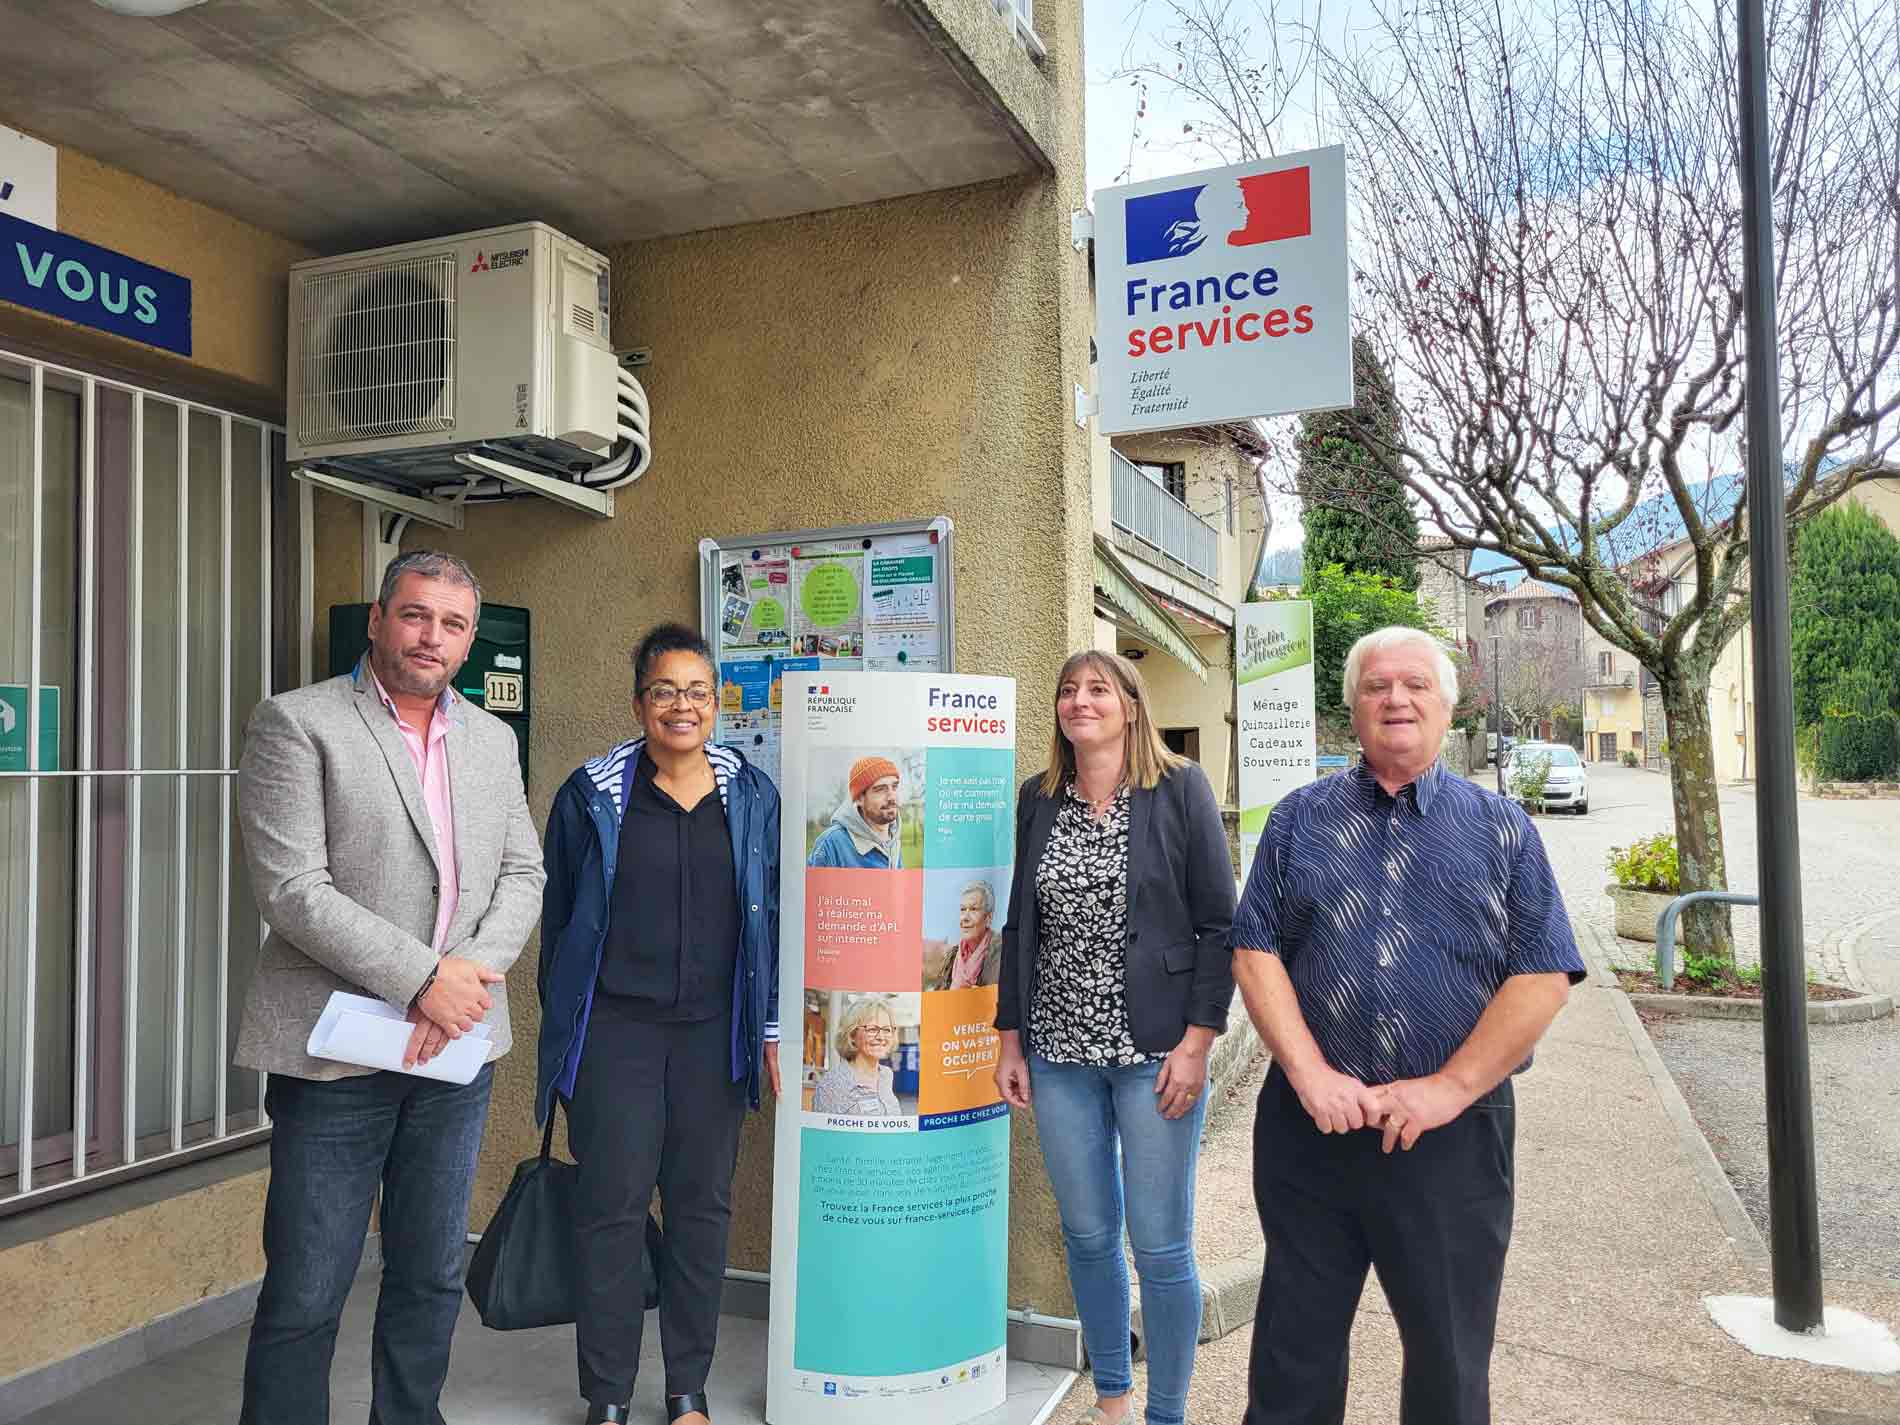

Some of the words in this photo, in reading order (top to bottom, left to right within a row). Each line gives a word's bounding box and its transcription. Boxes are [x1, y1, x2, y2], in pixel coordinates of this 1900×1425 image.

[491, 256, 523, 269] ELECTRIC
[16, 242, 157, 324] VOUS
[1127, 267, 1279, 316] France
[1127, 305, 1314, 358] services
[1130, 368, 1170, 384] Liberté
[1131, 384, 1171, 401] Égalité
[1131, 397, 1189, 416] Fraternité
[490, 682, 517, 702] 11B
[929, 688, 997, 710] France
[808, 696, 856, 706] RÉPUBLIQUE
[1253, 699, 1298, 712] Ménage
[928, 713, 1006, 734] services
[1241, 717, 1311, 731] Quincaillerie
[1250, 738, 1303, 749] Cadeaux
[1243, 756, 1310, 767] Souvenirs
[836, 896, 849, 906] du
[852, 897, 871, 906] mal
[866, 911, 882, 919] ma
[943, 1040, 960, 1052] ON
[962, 1039, 976, 1049] VA
[827, 1118, 863, 1128] PROCHE
[867, 1121, 879, 1129] DE
[882, 1120, 911, 1129] VOUS,
[924, 1115, 958, 1127] PROCHE
[960, 1113, 971, 1121] DE
[972, 1109, 989, 1119] CHEZ
[820, 1200, 857, 1212] Trouvez
[860, 1203, 869, 1212] la
[872, 1204, 904, 1213] France
[907, 1200, 943, 1212] services
[954, 1194, 970, 1205] plus
[822, 1214, 834, 1223] de
[837, 1215, 859, 1224] chez
[862, 1217, 885, 1225] vous
[887, 1217, 901, 1225] sur
